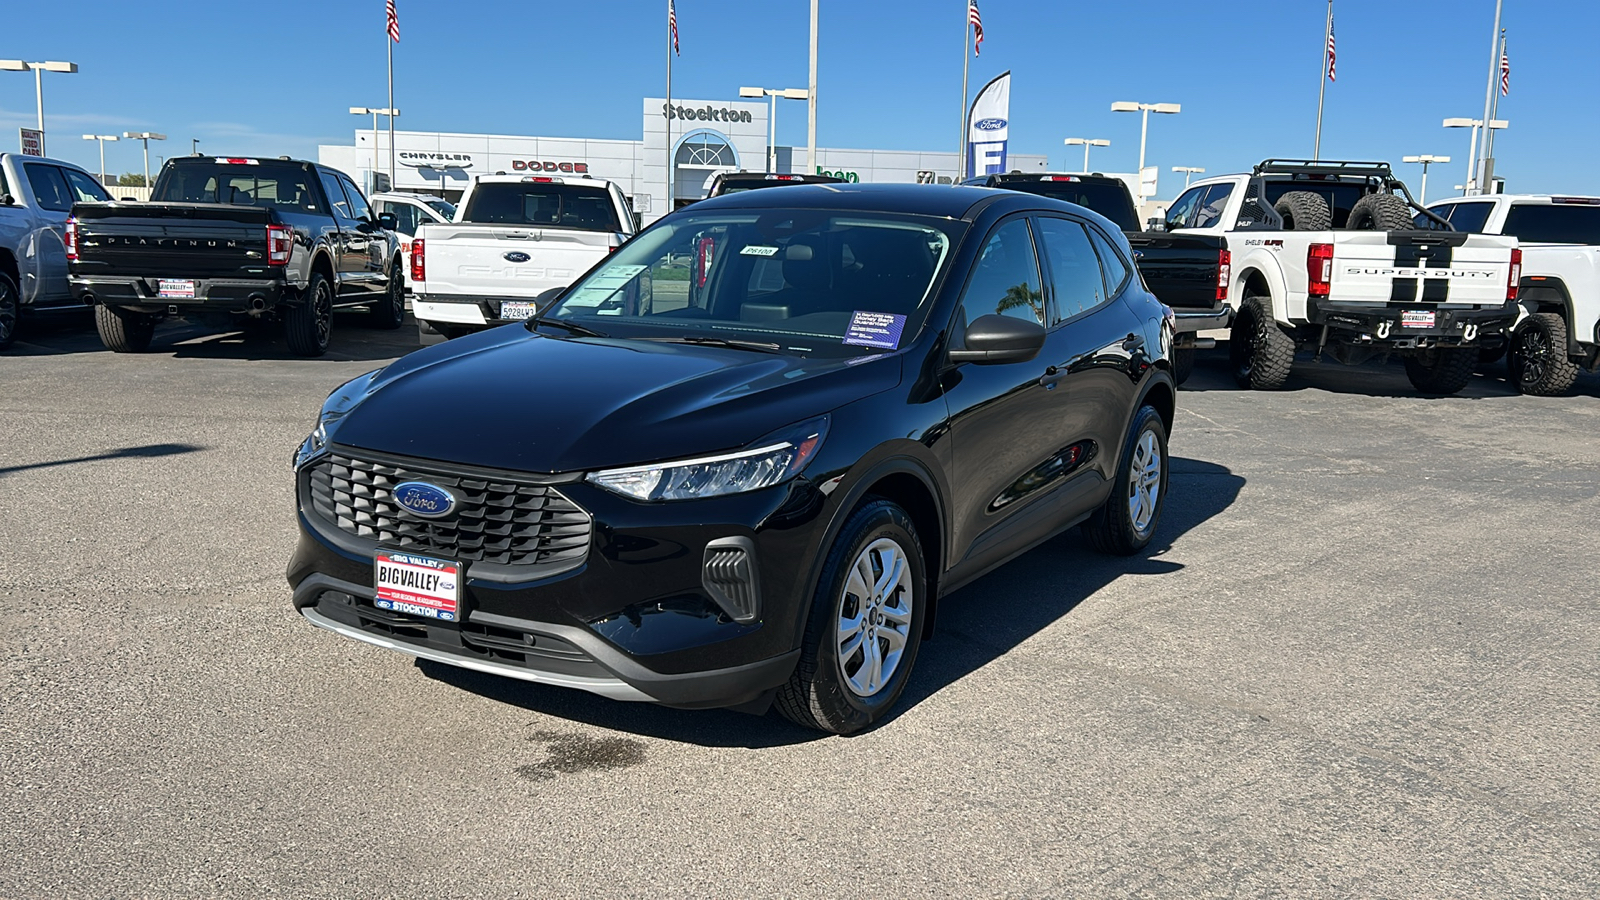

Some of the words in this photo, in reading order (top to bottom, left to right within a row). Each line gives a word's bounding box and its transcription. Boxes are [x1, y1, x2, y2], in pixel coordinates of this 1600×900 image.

[663, 103, 752, 123] Stockton
[980, 120, 1003, 129] Ford
[24, 139, 38, 148] USED
[23, 148, 40, 156] CARS
[399, 152, 472, 162] CHRYSLER
[512, 160, 588, 173] DODGE
[108, 238, 237, 248] PLATINUM
[745, 247, 773, 255] P6100
[458, 265, 577, 279] F-150
[1347, 268, 1427, 276] SUPER
[403, 488, 438, 511] Ford
[393, 554, 408, 563] BIG
[408, 556, 438, 568] VALLEY
[379, 566, 440, 592] BIGVALLEY
[392, 602, 438, 617] STOCKTON
